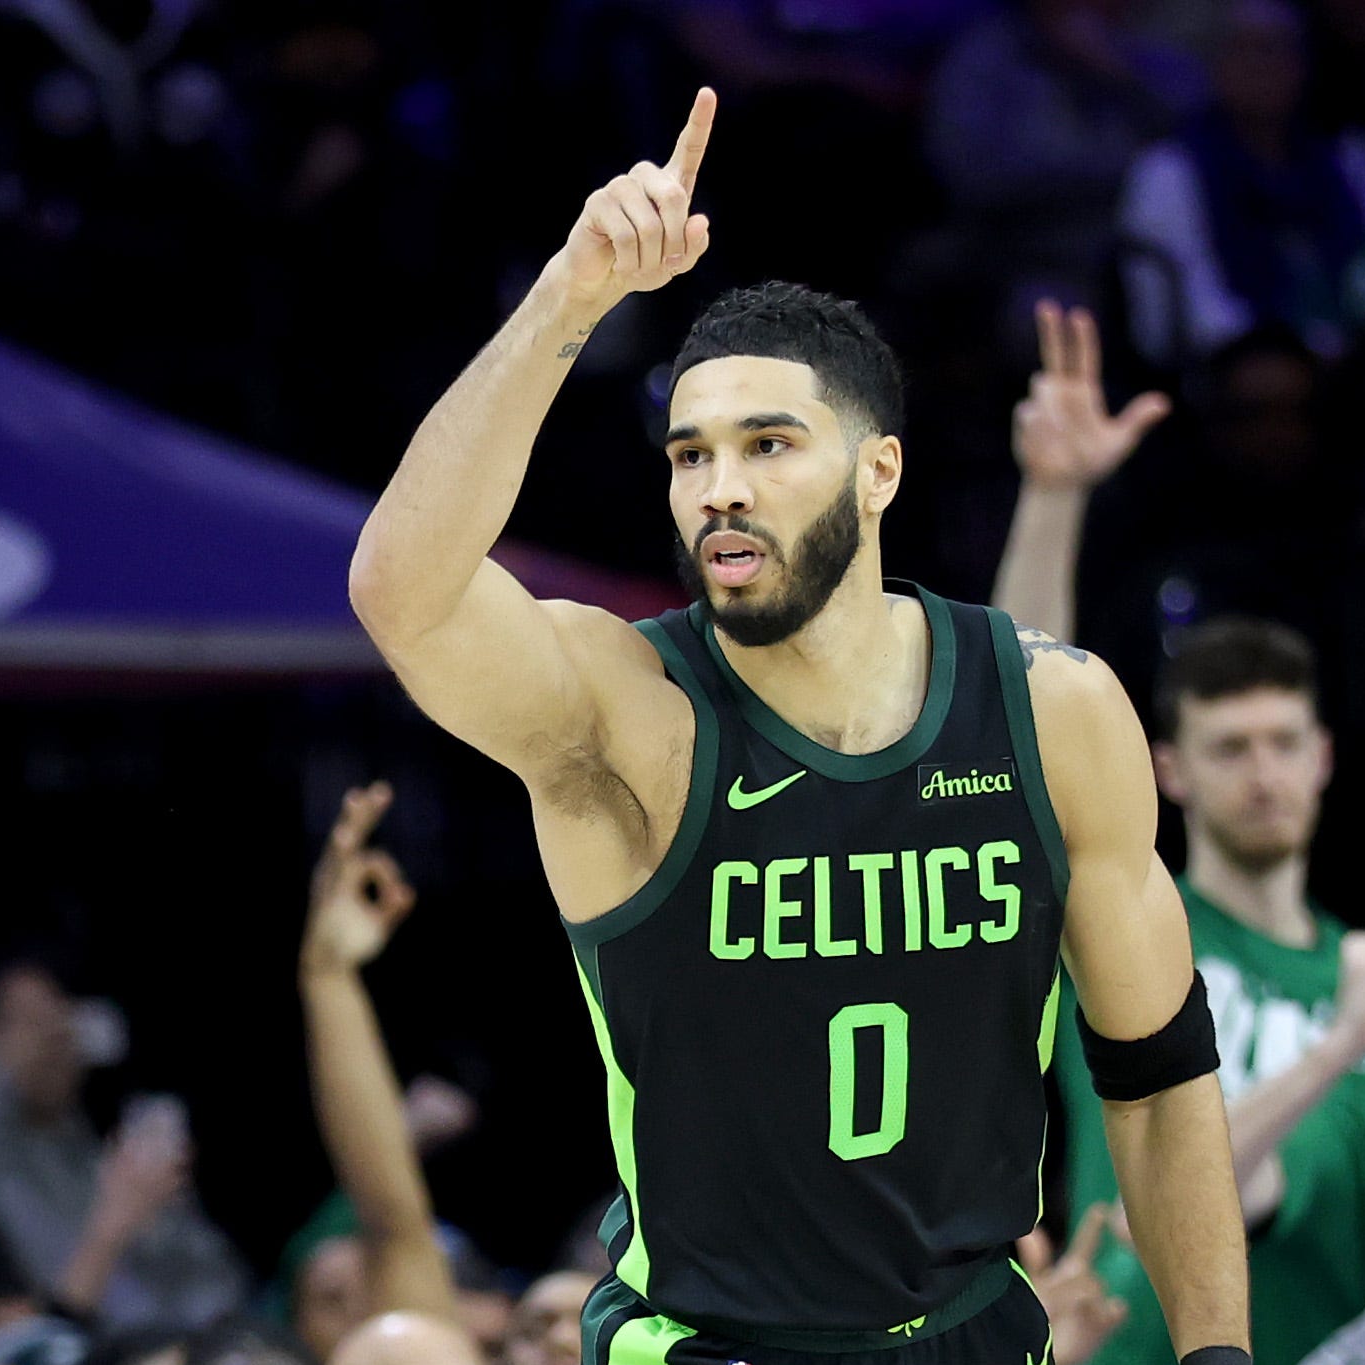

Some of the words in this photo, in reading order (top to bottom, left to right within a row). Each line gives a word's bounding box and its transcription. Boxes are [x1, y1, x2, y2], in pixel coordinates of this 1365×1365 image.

[921, 769, 1013, 800] Amica
[709, 840, 1022, 960] CELTICS
[828, 1002, 909, 1161] 0
